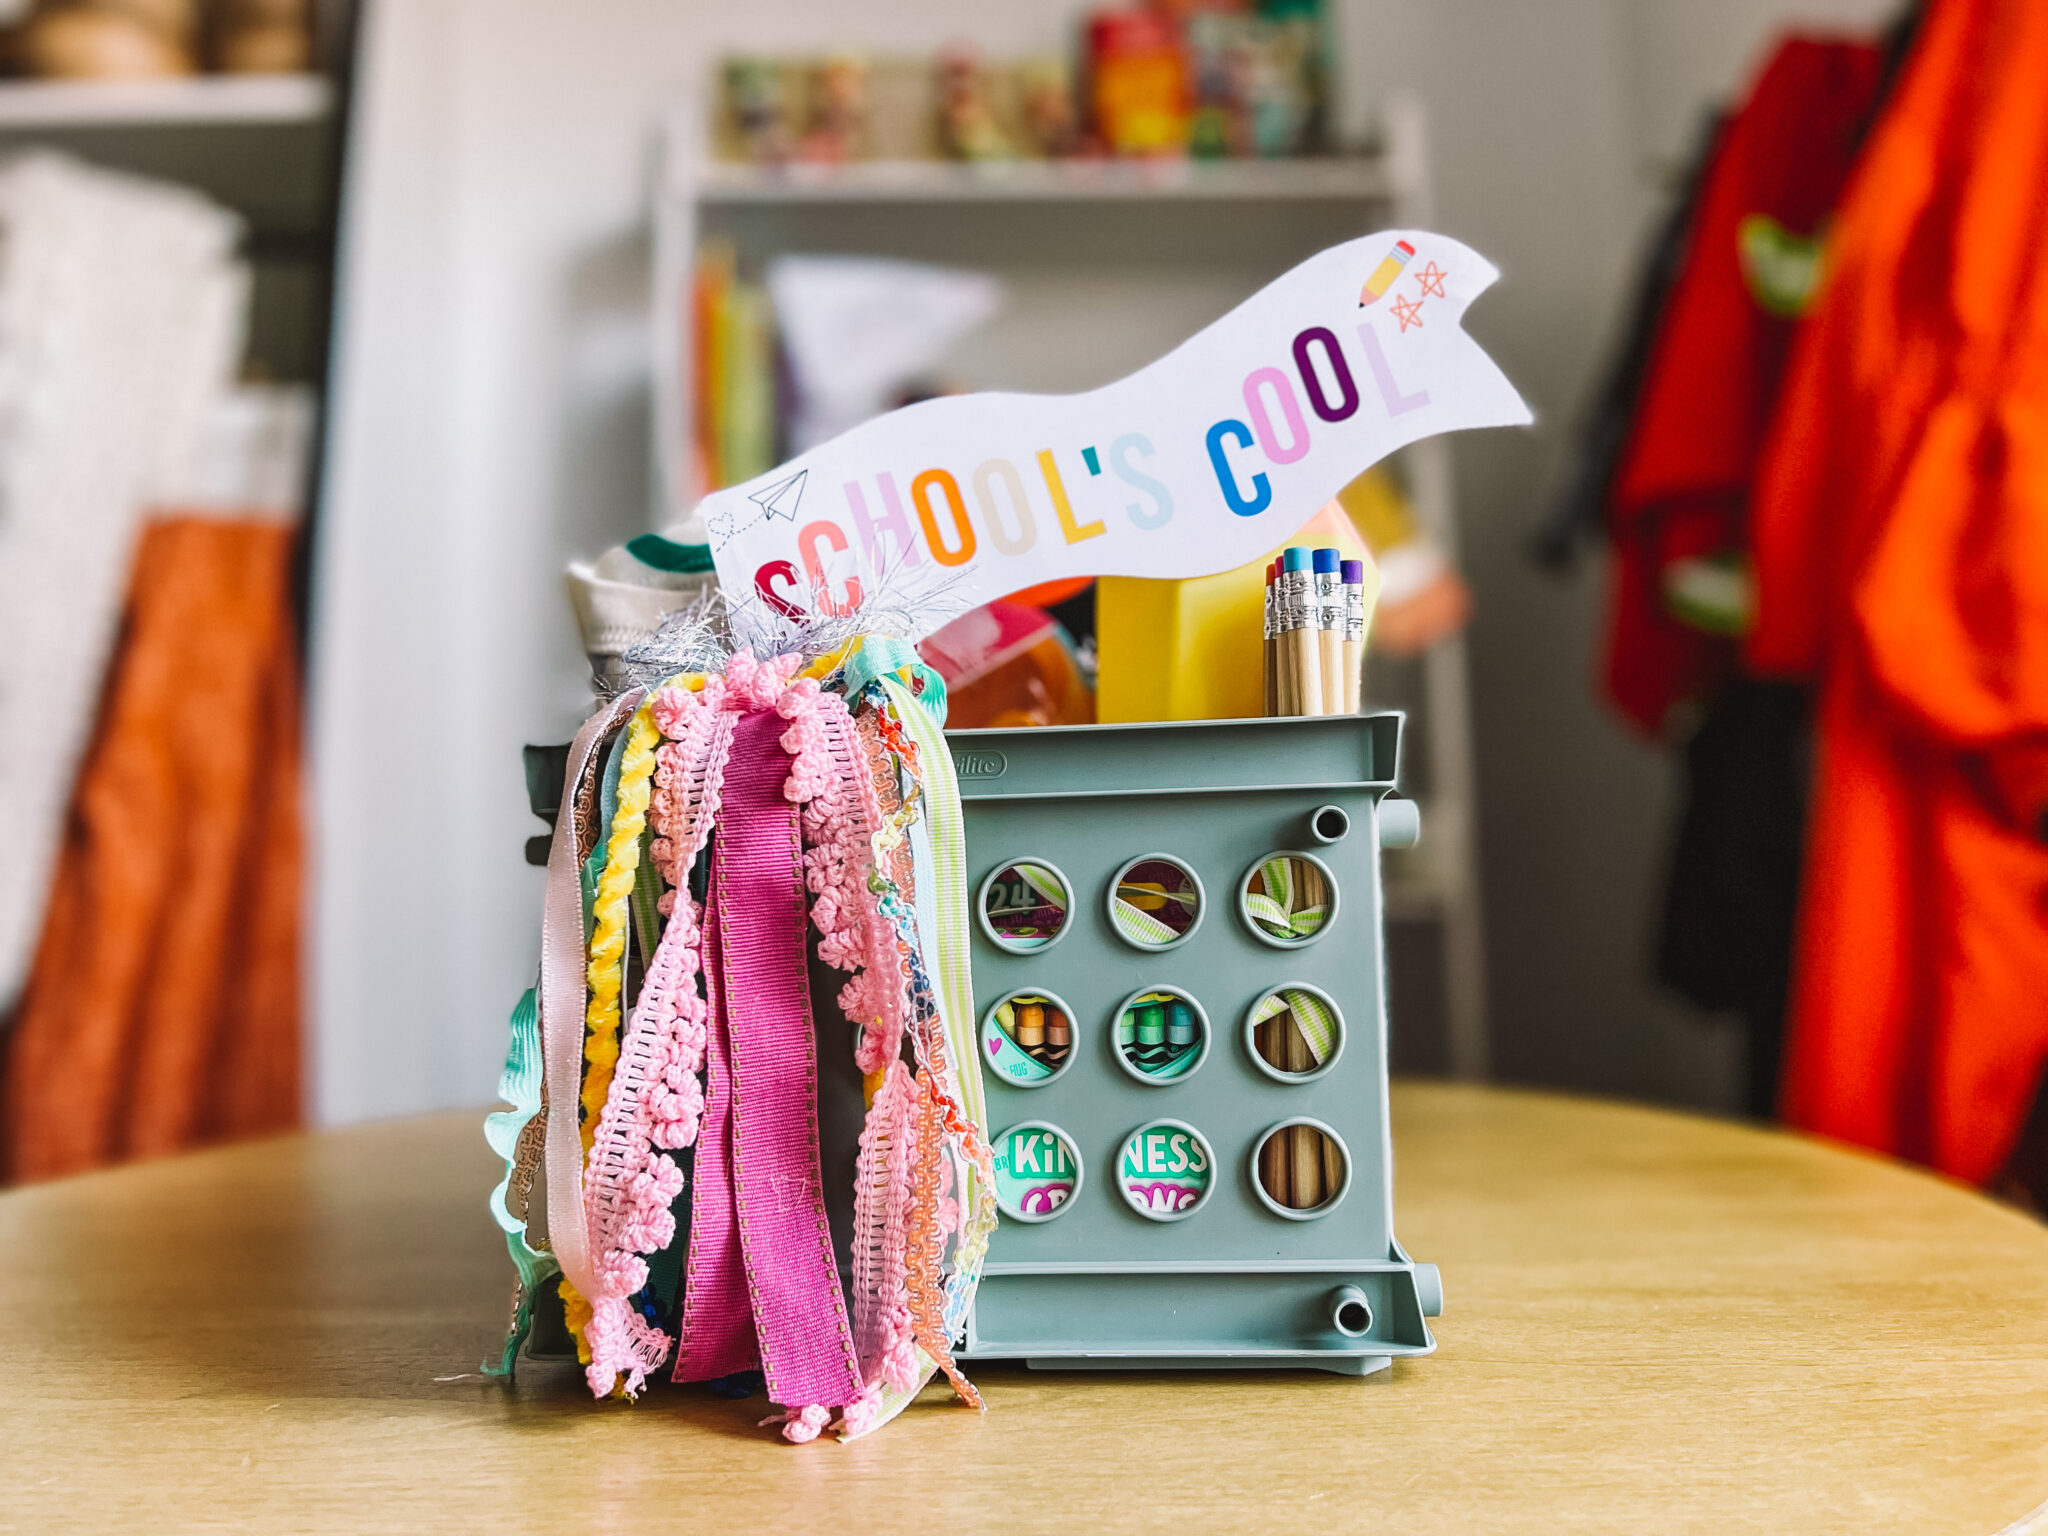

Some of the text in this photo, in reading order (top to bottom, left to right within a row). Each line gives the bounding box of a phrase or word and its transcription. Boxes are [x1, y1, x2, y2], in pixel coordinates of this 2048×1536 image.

[754, 322, 1431, 626] SCHOOL'S COOL
[988, 880, 1036, 915] 24
